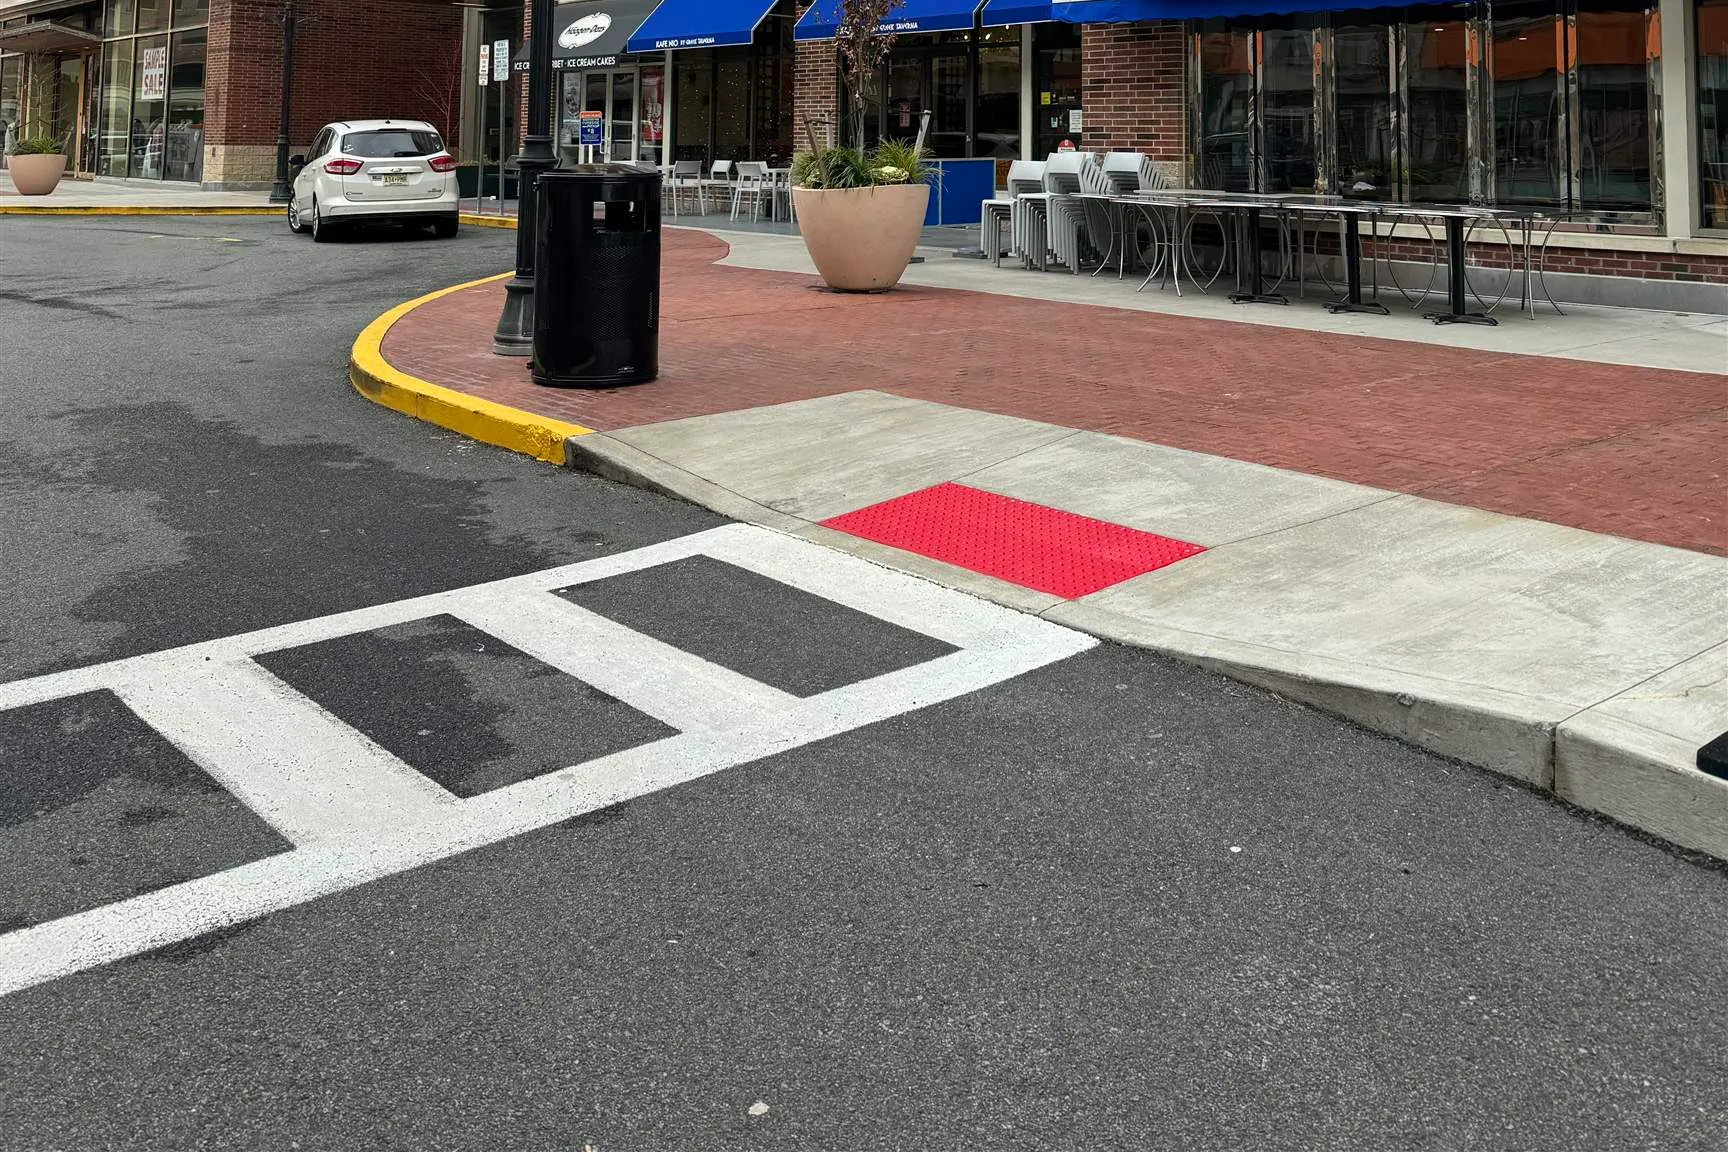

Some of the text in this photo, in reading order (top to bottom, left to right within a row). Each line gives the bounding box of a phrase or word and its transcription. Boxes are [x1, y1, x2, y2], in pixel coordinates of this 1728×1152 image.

[655, 40, 668, 48] KAFE
[144, 49, 165, 69] SAMPLE
[514, 61, 522, 70] ICE
[567, 58, 576, 68] ICE
[576, 57, 596, 67] CREAM
[596, 56, 616, 66] CAKES
[143, 73, 163, 95] SALE
